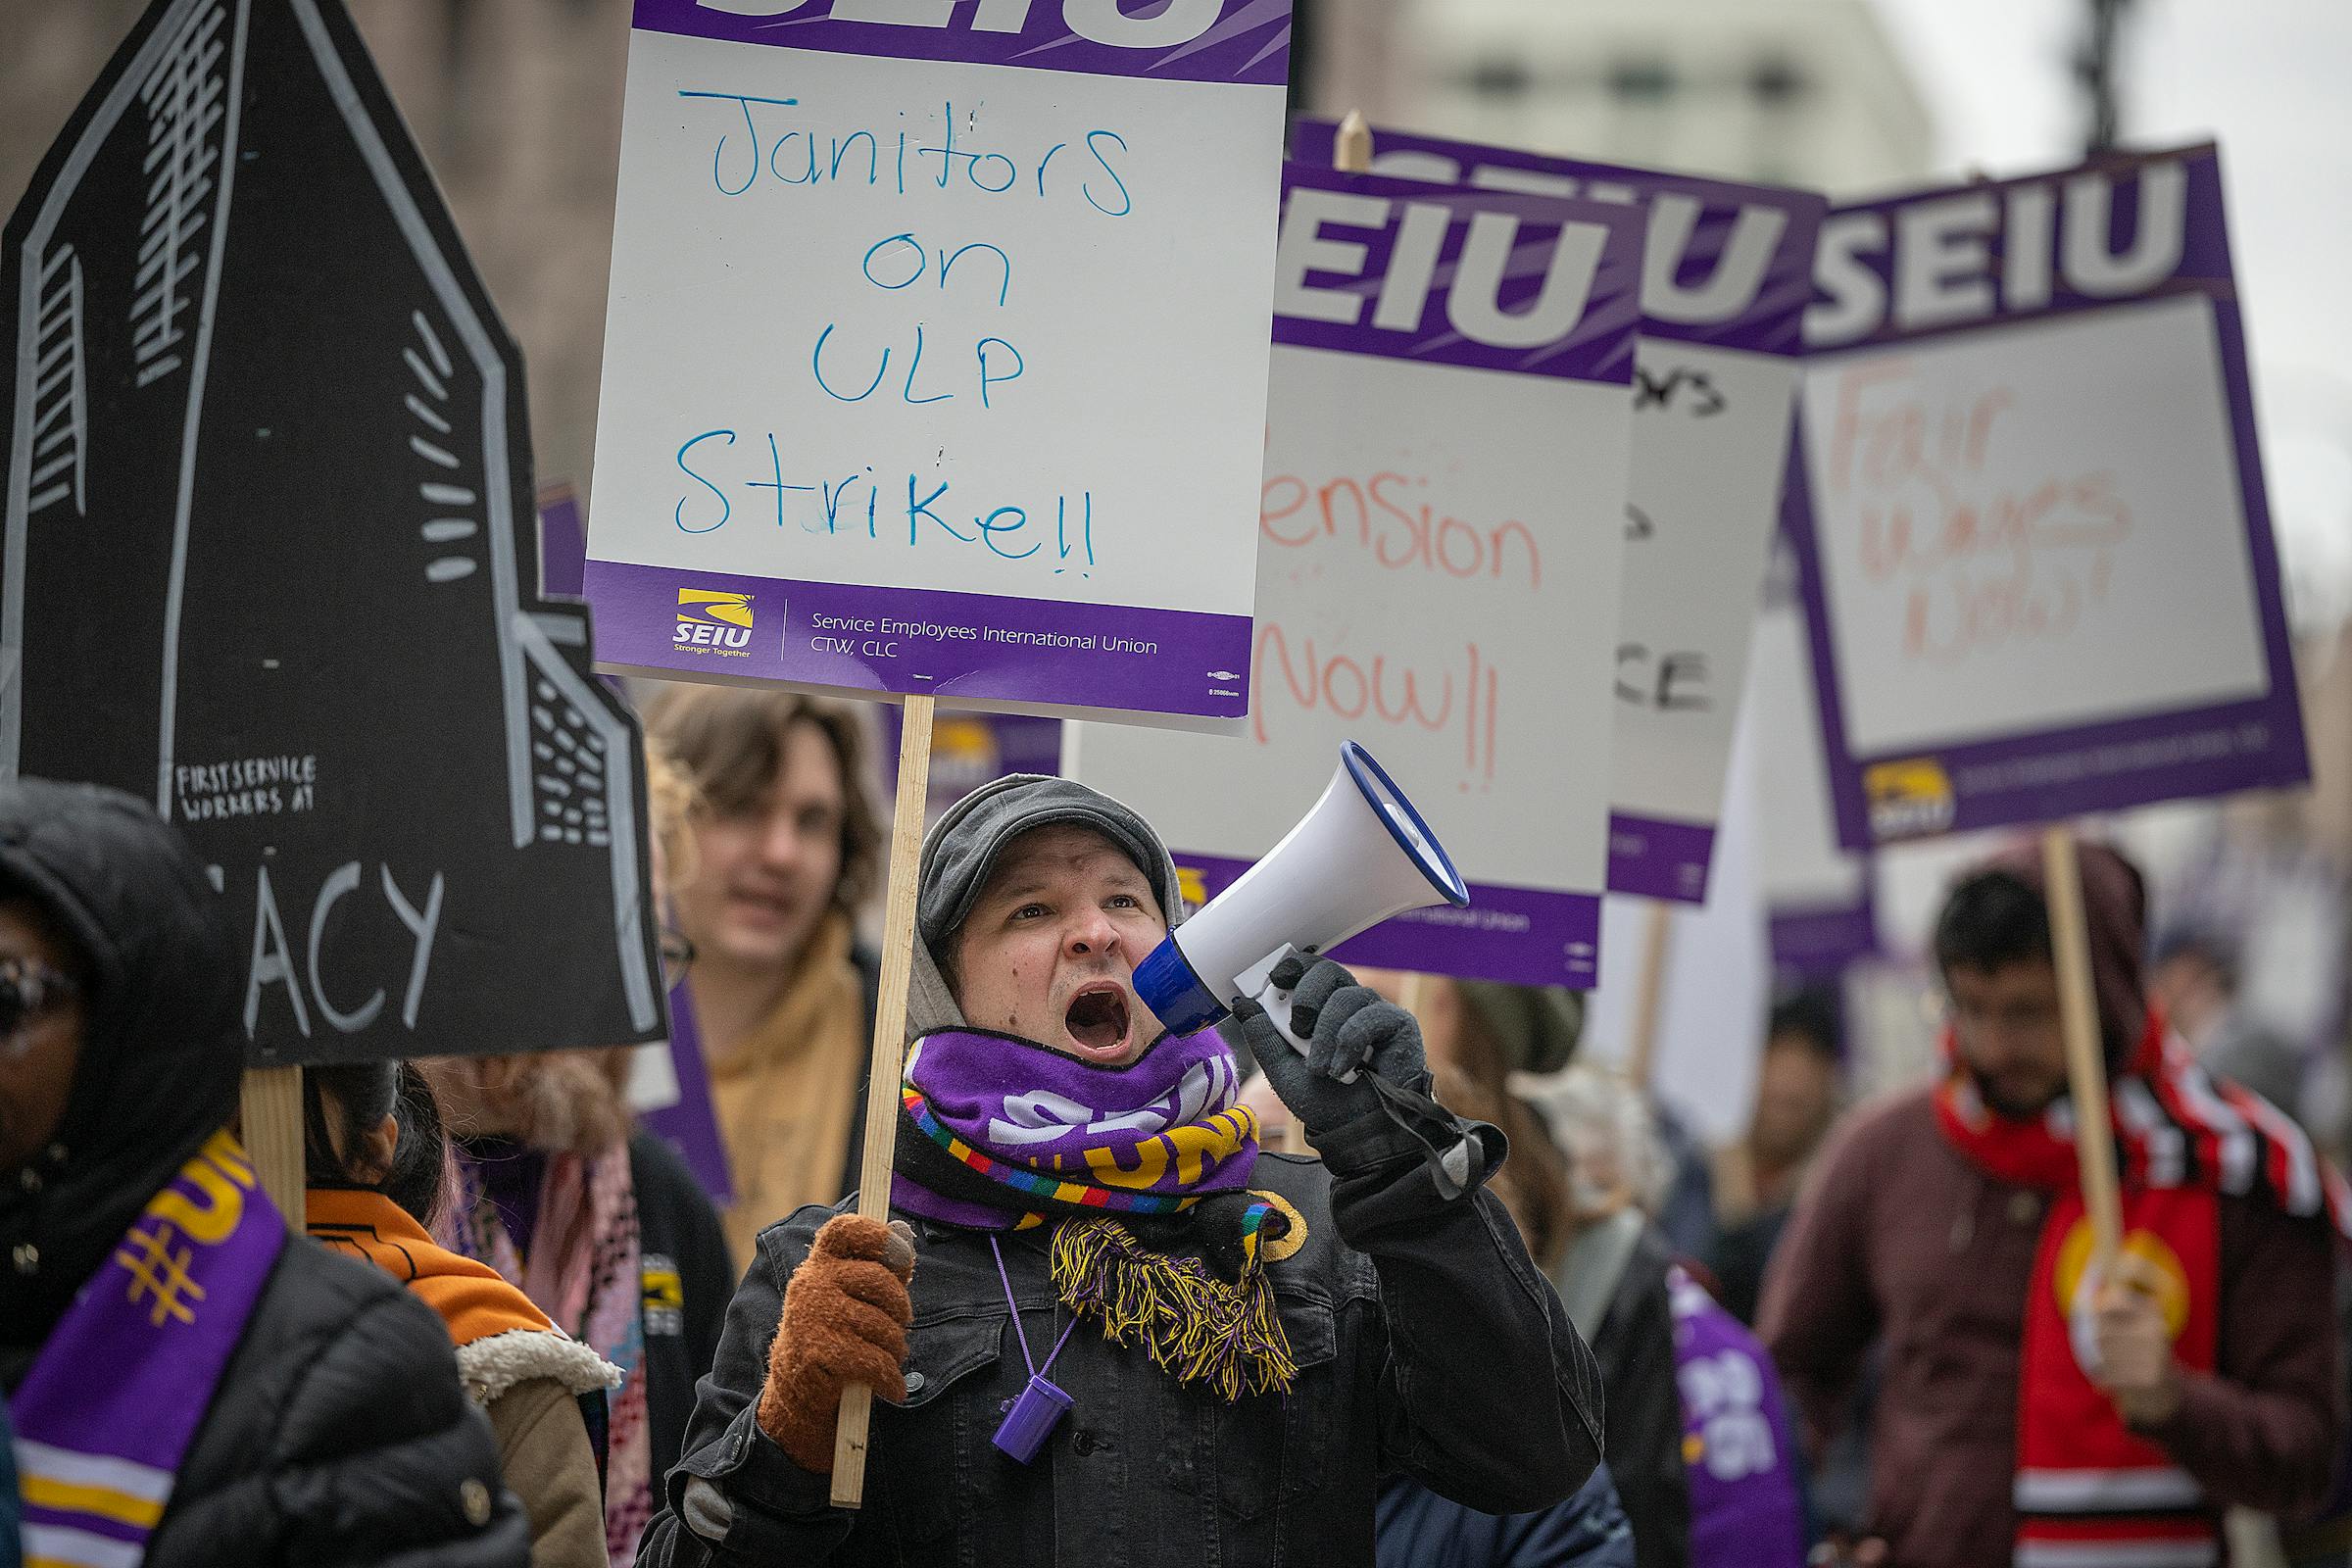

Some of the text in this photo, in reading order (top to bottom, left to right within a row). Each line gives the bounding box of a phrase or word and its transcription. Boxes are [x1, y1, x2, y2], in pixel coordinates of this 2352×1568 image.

[678, 90, 1132, 217] Janitors
[863, 232, 1010, 307] on
[1273, 186, 1611, 349] EIU
[1800, 160, 2188, 349] SEIU
[812, 322, 1025, 409] ULP
[1260, 470, 1543, 590] ension
[672, 622, 753, 648] SEIU
[673, 644, 751, 658] Stronger Together
[810, 636, 899, 659] CTW, CLC
[811, 612, 1158, 655] Service Employees International Union
[207, 861, 444, 1039] ACY
